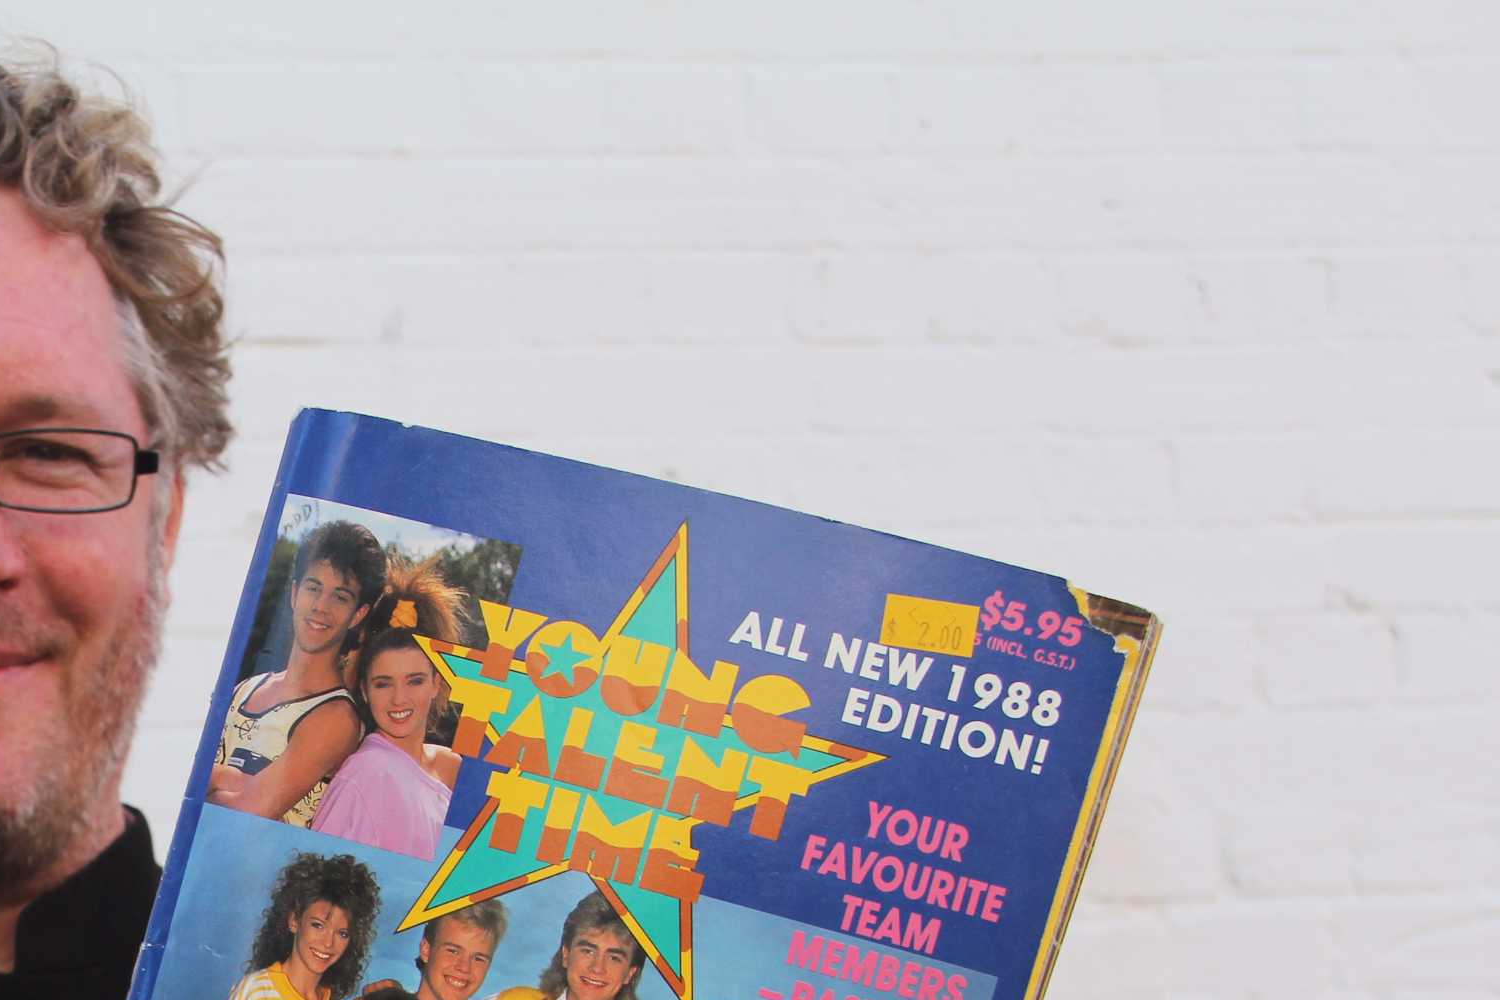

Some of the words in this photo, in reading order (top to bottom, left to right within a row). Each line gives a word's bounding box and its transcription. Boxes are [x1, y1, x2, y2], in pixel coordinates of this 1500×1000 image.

[981, 590, 1084, 647] $5.95
[479, 600, 812, 760] YOUNG
[729, 611, 809, 662] ALL
[823, 633, 934, 691] NEW
[947, 664, 1062, 727] 1988
[449, 676, 815, 841] TALENT
[841, 687, 1050, 775] EDITION!
[485, 770, 705, 903] TIME
[867, 800, 969, 862] YOUR
[800, 834, 1007, 923] FAVOURITE
[840, 894, 942, 955] TEAM
